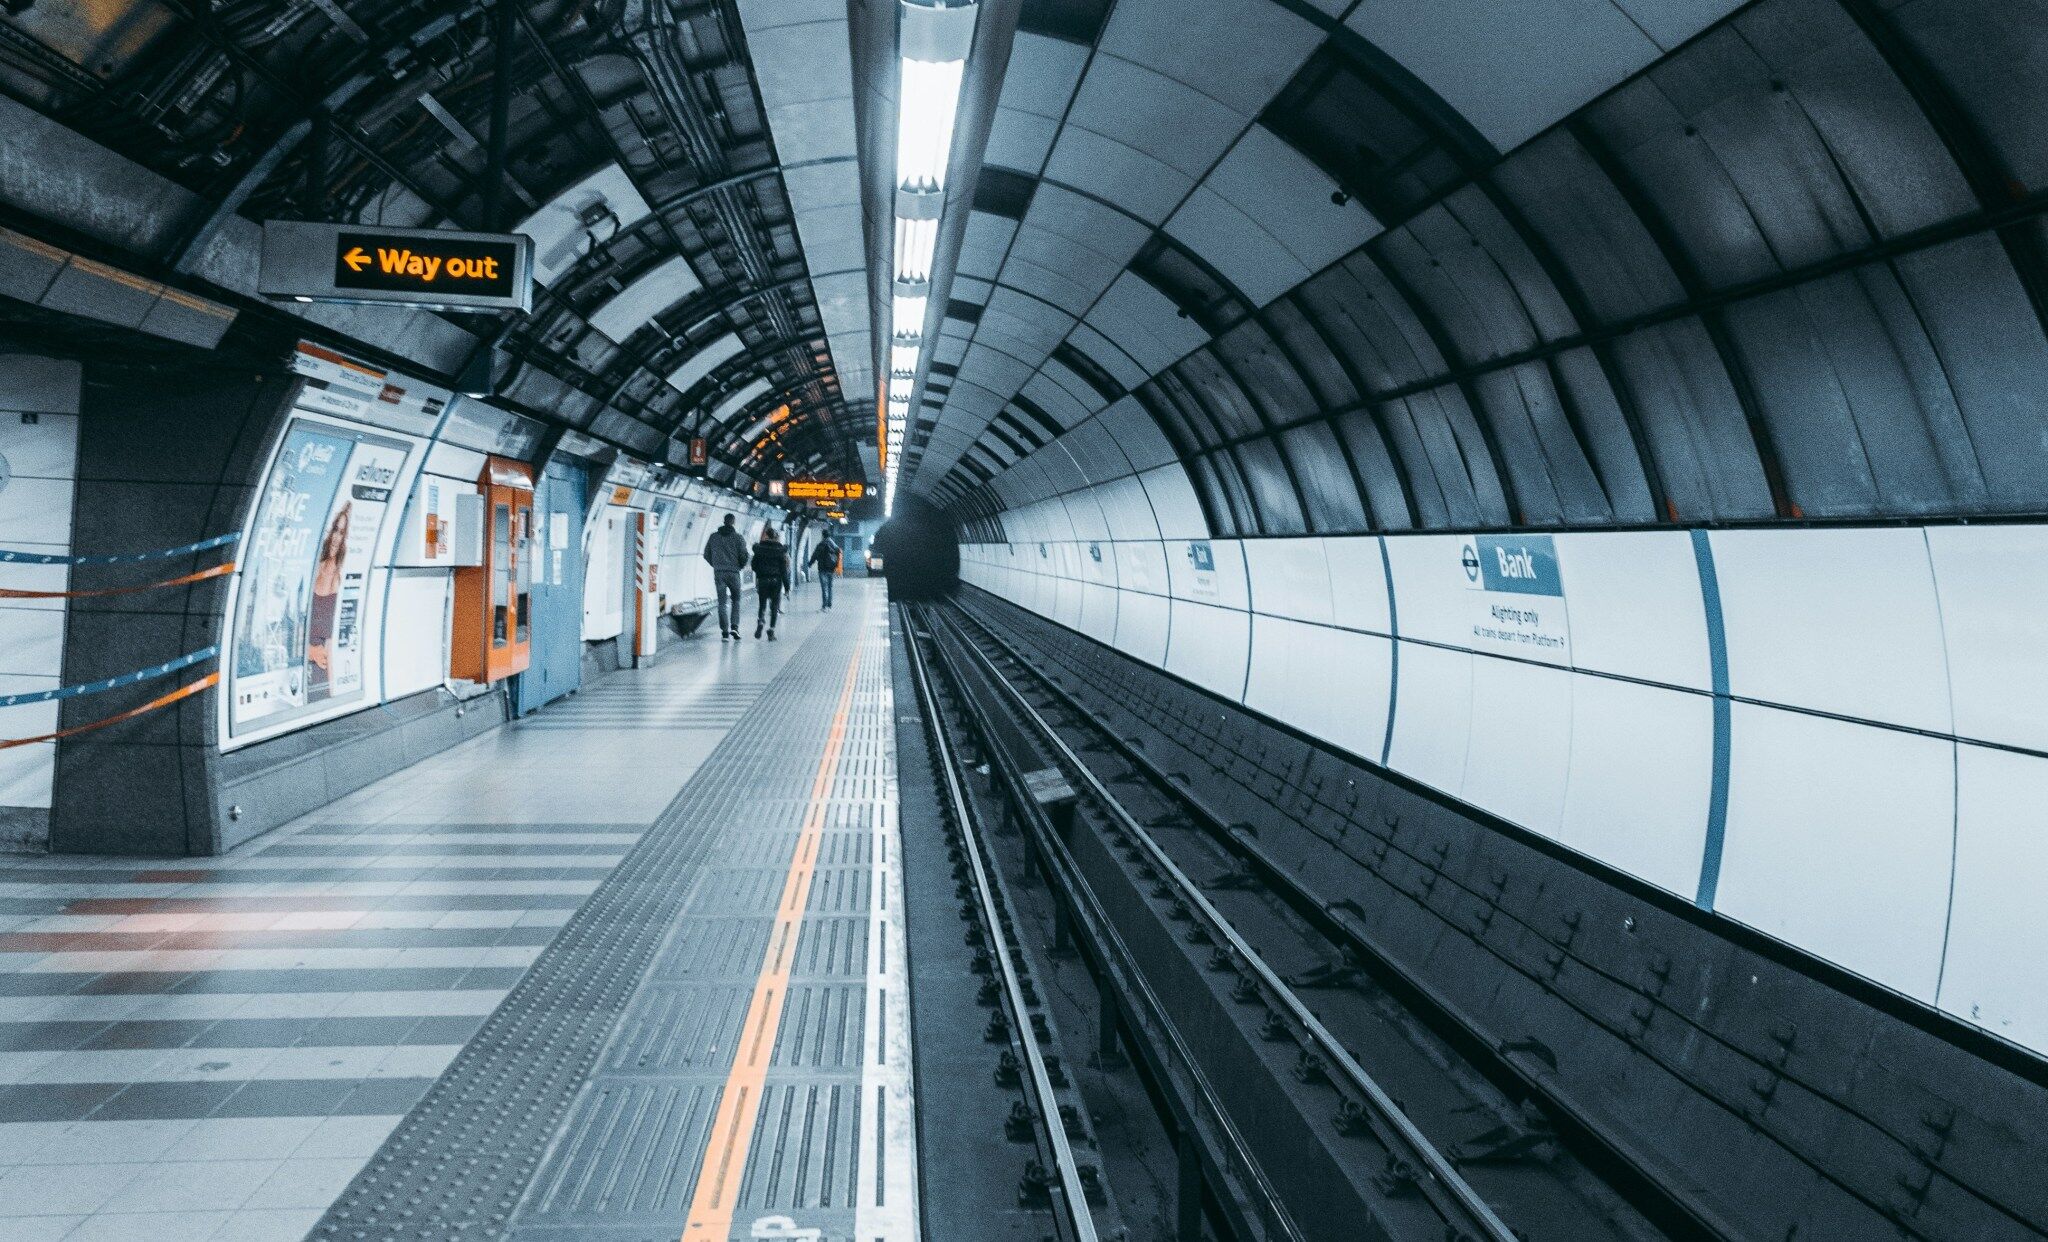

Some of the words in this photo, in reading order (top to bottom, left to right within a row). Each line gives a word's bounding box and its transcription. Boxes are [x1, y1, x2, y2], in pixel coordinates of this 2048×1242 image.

[377, 248, 442, 281] Way
[447, 256, 498, 279] out
[253, 527, 311, 558] FLIGHT
[1495, 546, 1537, 579] Bank
[1491, 604, 1522, 625] Alighting
[1523, 609, 1539, 628] only
[1481, 627, 1497, 639] trains
[1498, 628, 1516, 642] depart
[1517, 630, 1531, 644] from
[1532, 632, 1559, 648] Platform
